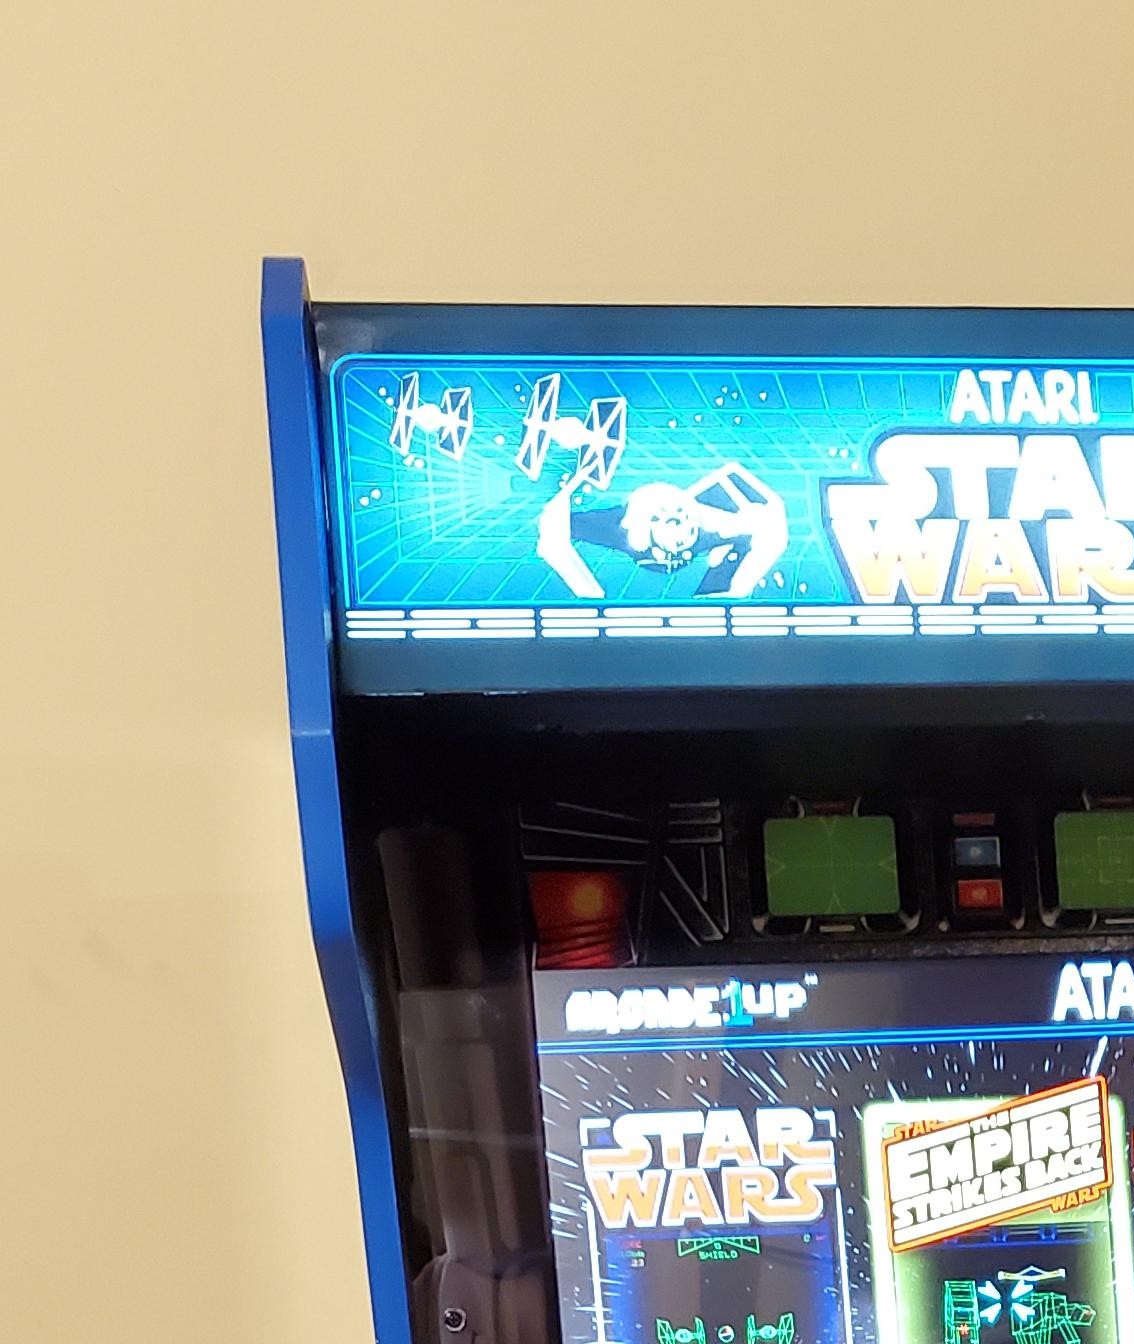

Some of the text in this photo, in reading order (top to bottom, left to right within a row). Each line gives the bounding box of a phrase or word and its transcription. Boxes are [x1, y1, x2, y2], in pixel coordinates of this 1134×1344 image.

[948, 369, 1092, 424] ATARI
[582, 1107, 836, 1171] STAR
[887, 1098, 1102, 1202] EMPIRE
[893, 1118, 942, 1140] STAR
[585, 1163, 838, 1229] WARS
[891, 1141, 1105, 1230] STRIKES BACK
[1049, 1186, 1103, 1214] WARS
[698, 1250, 739, 1261] SHIELD
